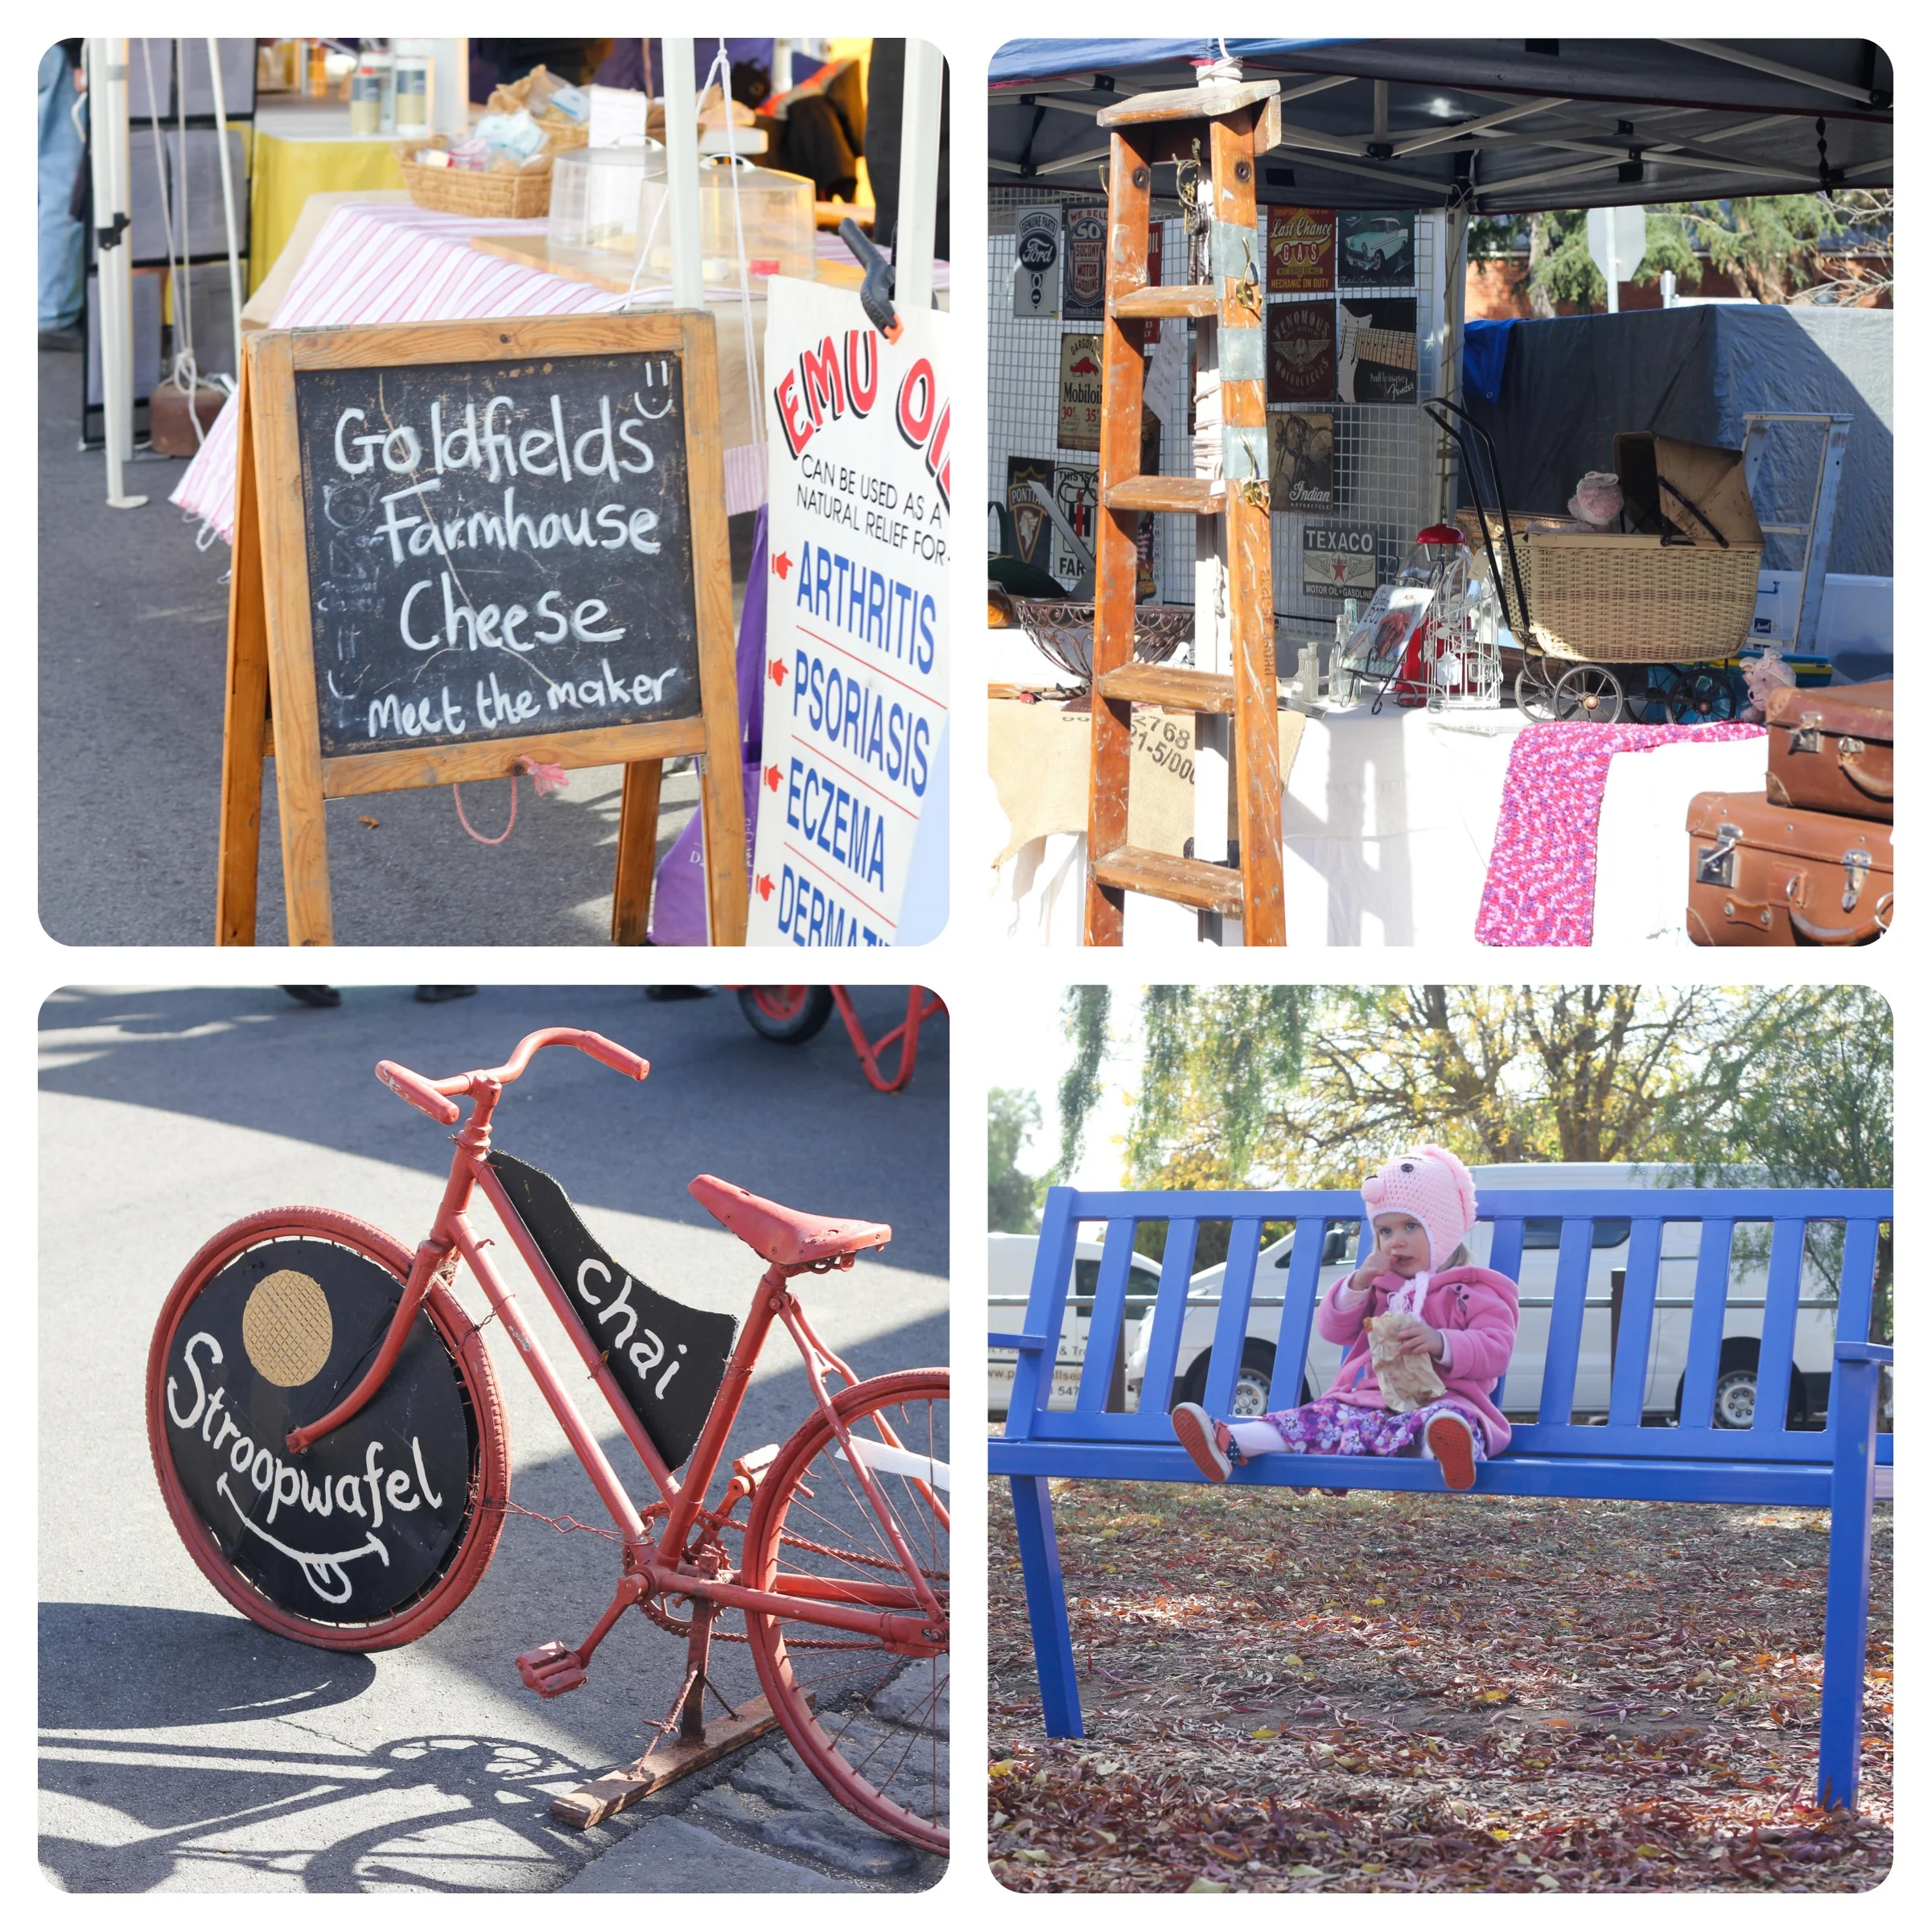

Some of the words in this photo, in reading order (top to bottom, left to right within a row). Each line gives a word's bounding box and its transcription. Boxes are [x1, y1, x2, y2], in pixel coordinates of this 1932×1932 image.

[1022, 216, 1041, 233] GENUINE
[1042, 216, 1056, 233] PARTS
[1070, 210, 1083, 222] WE
[1270, 218, 1295, 238] Last
[1296, 216, 1333, 237] Chance
[1022, 237, 1053, 262] Ford
[1076, 244, 1100, 257] SOCONY
[1283, 243, 1316, 261] GAS
[1077, 264, 1098, 278] MOTOR
[1271, 278, 1301, 288] MECHANIC
[1304, 279, 1312, 288] ON
[1313, 278, 1329, 288] DUTY
[1075, 278, 1098, 294] GASOLINE
[1273, 310, 1330, 340] VENOMOUS
[1275, 357, 1329, 387] MOTORCYCLES
[773, 330, 878, 461] EMU
[1063, 382, 1102, 404] Mobiloil
[1387, 377, 1415, 401] Fender
[334, 394, 655, 484] Goldfields
[1058, 471, 1078, 481] THIS
[801, 454, 835, 487] CAN
[839, 467, 856, 495] BE
[860, 474, 898, 510] USED
[903, 492, 925, 521] AS
[929, 502, 942, 529] A
[1011, 487, 1043, 506] PONTIA
[1289, 480, 1331, 502] Indian
[374, 478, 661, 566] Farmhouse
[797, 484, 859, 531] NATURAL
[865, 511, 909, 550] RELIEF
[912, 529, 946, 566] FOR
[1305, 529, 1374, 553] TEXACO
[1059, 556, 1086, 577] FAR
[1305, 584, 1328, 595] MOTOR
[1329, 585, 1339, 595] OIL
[1342, 588, 1373, 599] GASOLINE
[400, 571, 627, 651] Cheese
[797, 540, 937, 675] ARTHRITIS
[368, 686, 466, 738] Meet
[477, 671, 540, 729] the
[547, 658, 678, 711] maker
[793, 648, 930, 798] PSORIASIS
[1132, 715, 1190, 751] 2768
[786, 756, 884, 893] ECZEMA
[777, 863, 892, 947] DERMA
[1058, 1386, 1080, 1396] 547
[167, 1331, 443, 1529] Stroopwafel
